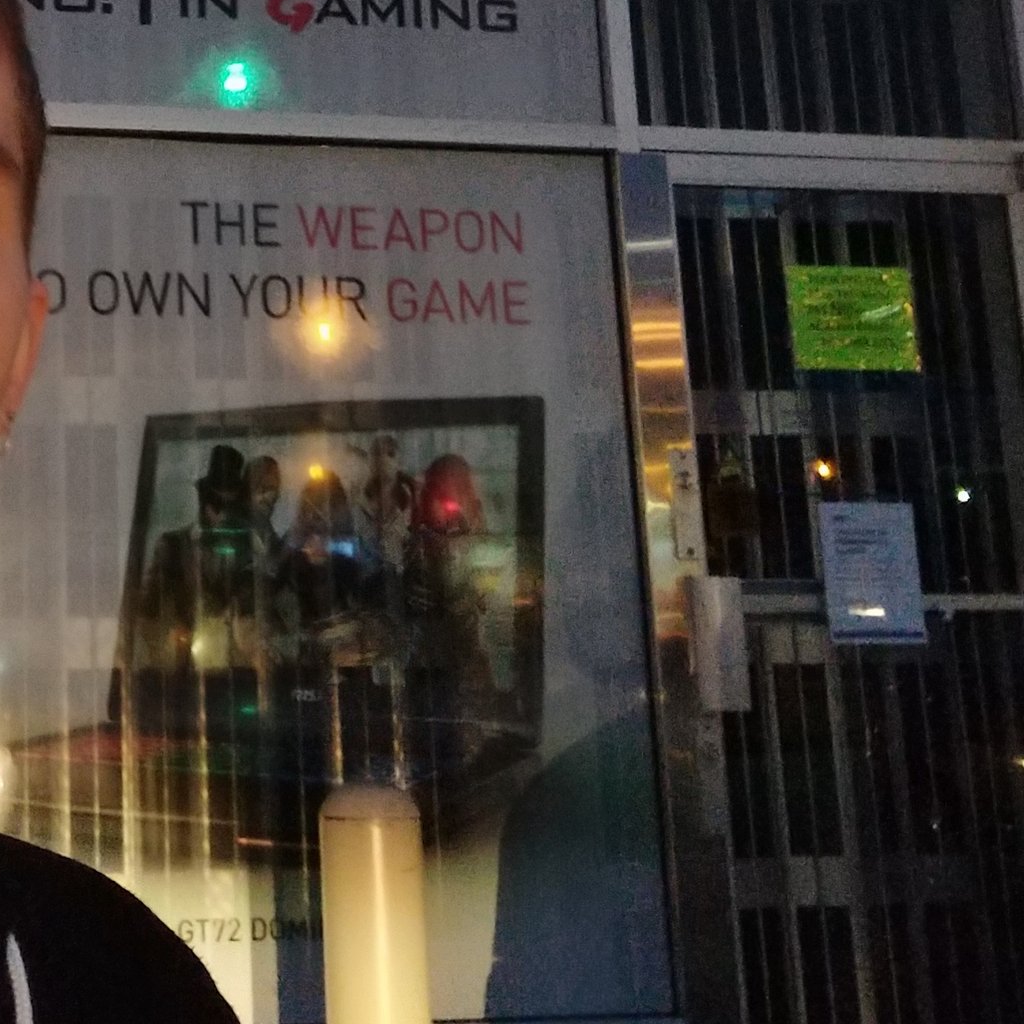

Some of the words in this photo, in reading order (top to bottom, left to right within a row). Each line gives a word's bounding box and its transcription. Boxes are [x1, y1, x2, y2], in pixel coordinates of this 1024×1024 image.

[181, 201, 280, 247] THE
[297, 204, 525, 254] WEAPON
[88, 271, 212, 318] OWN
[228, 274, 368, 322] YOUR
[387, 277, 533, 326] GAME
[177, 918, 242, 944] GT72
